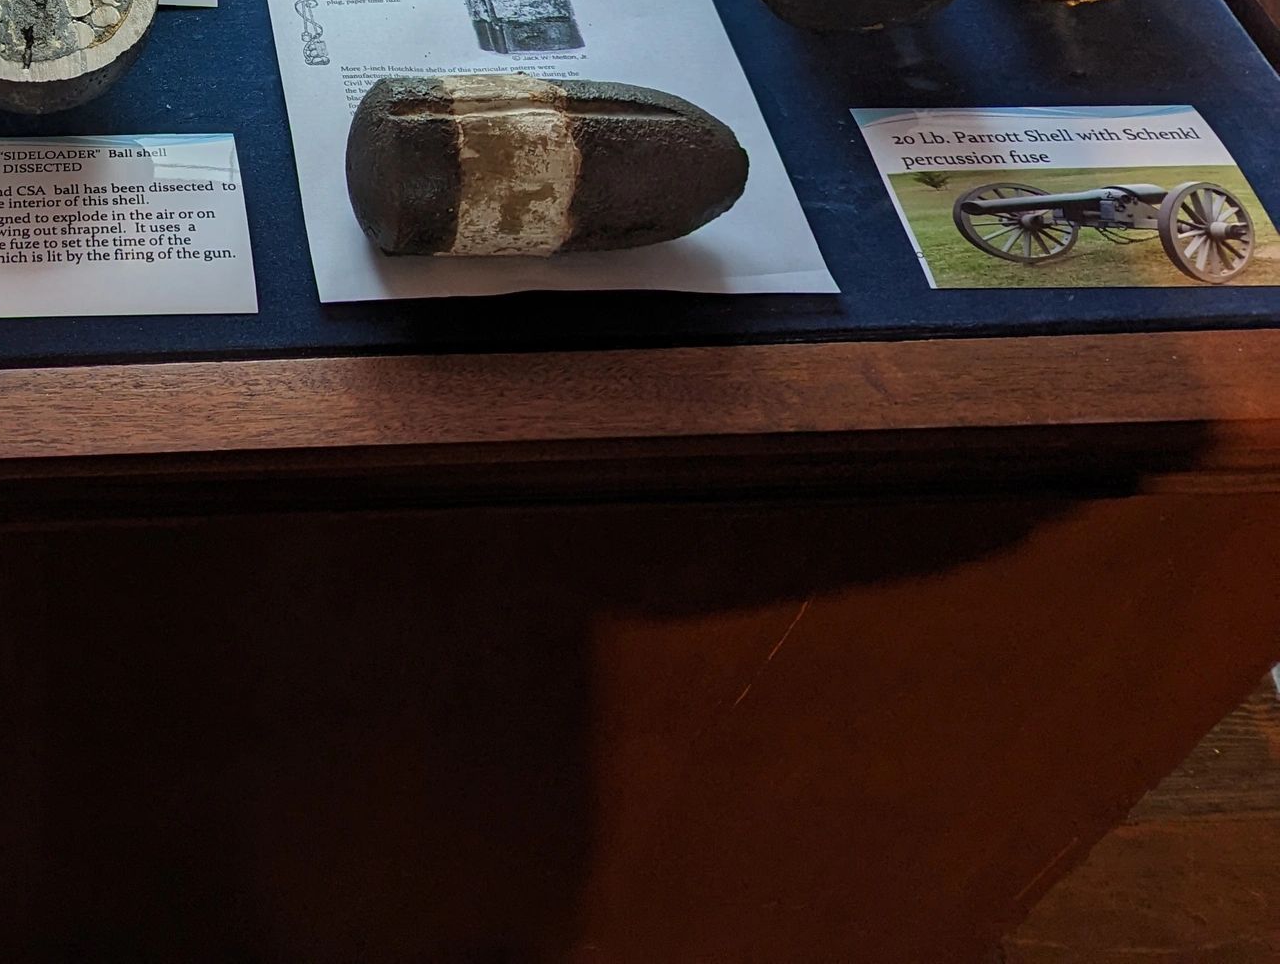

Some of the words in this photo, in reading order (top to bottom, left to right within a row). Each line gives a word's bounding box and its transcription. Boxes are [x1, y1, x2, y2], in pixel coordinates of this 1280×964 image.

[891, 135, 915, 145] 20
[920, 130, 950, 144] Lb.
[954, 129, 1023, 144] Parrott
[1024, 128, 1074, 142] Shell
[1074, 128, 1122, 142] with
[1122, 126, 1201, 141] Schenkl
[108, 148, 133, 159] Ball
[136, 147, 166, 158] shell
[899, 151, 1007, 170] percussion
[1008, 150, 1053, 164] fuse
[2, 161, 82, 174] DISSECTED
[16, 184, 46, 197] CSA
[54, 184, 79, 196] ball
[83, 183, 107, 195] has
[111, 182, 145, 194] been
[148, 180, 214, 194] dissected
[221, 179, 236, 192] to
[8, 196, 61, 210] interior
[64, 196, 78, 208] of
[81, 195, 108, 207] this
[111, 193, 149, 206] shell.
[34, 212, 49, 224] to
[52, 210, 108, 227] explode
[111, 210, 126, 222] in
[129, 209, 152, 221] the
[155, 208, 175, 220] air
[178, 211, 194, 220] or
[196, 210, 215, 219] on
[33, 225, 57, 237] out
[60, 223, 126, 240] shrapnel.
[135, 222, 146, 234] It
[148, 225, 180, 234] uses
[187, 224, 196, 233] a
[9, 238, 40, 251] fuze
[42, 238, 58, 250] to
[61, 237, 82, 249] set
[85, 236, 109, 248] the
[111, 235, 145, 248] time
[148, 234, 163, 246] of
[166, 234, 191, 246] the
[31, 252, 43, 264] is
[46, 251, 62, 263] lit
[66, 250, 82, 266] by
[86, 250, 110, 262] the
[113, 249, 155, 265] firing
[157, 248, 172, 260] of
[175, 248, 200, 260] the
[203, 250, 236, 263] gun.
